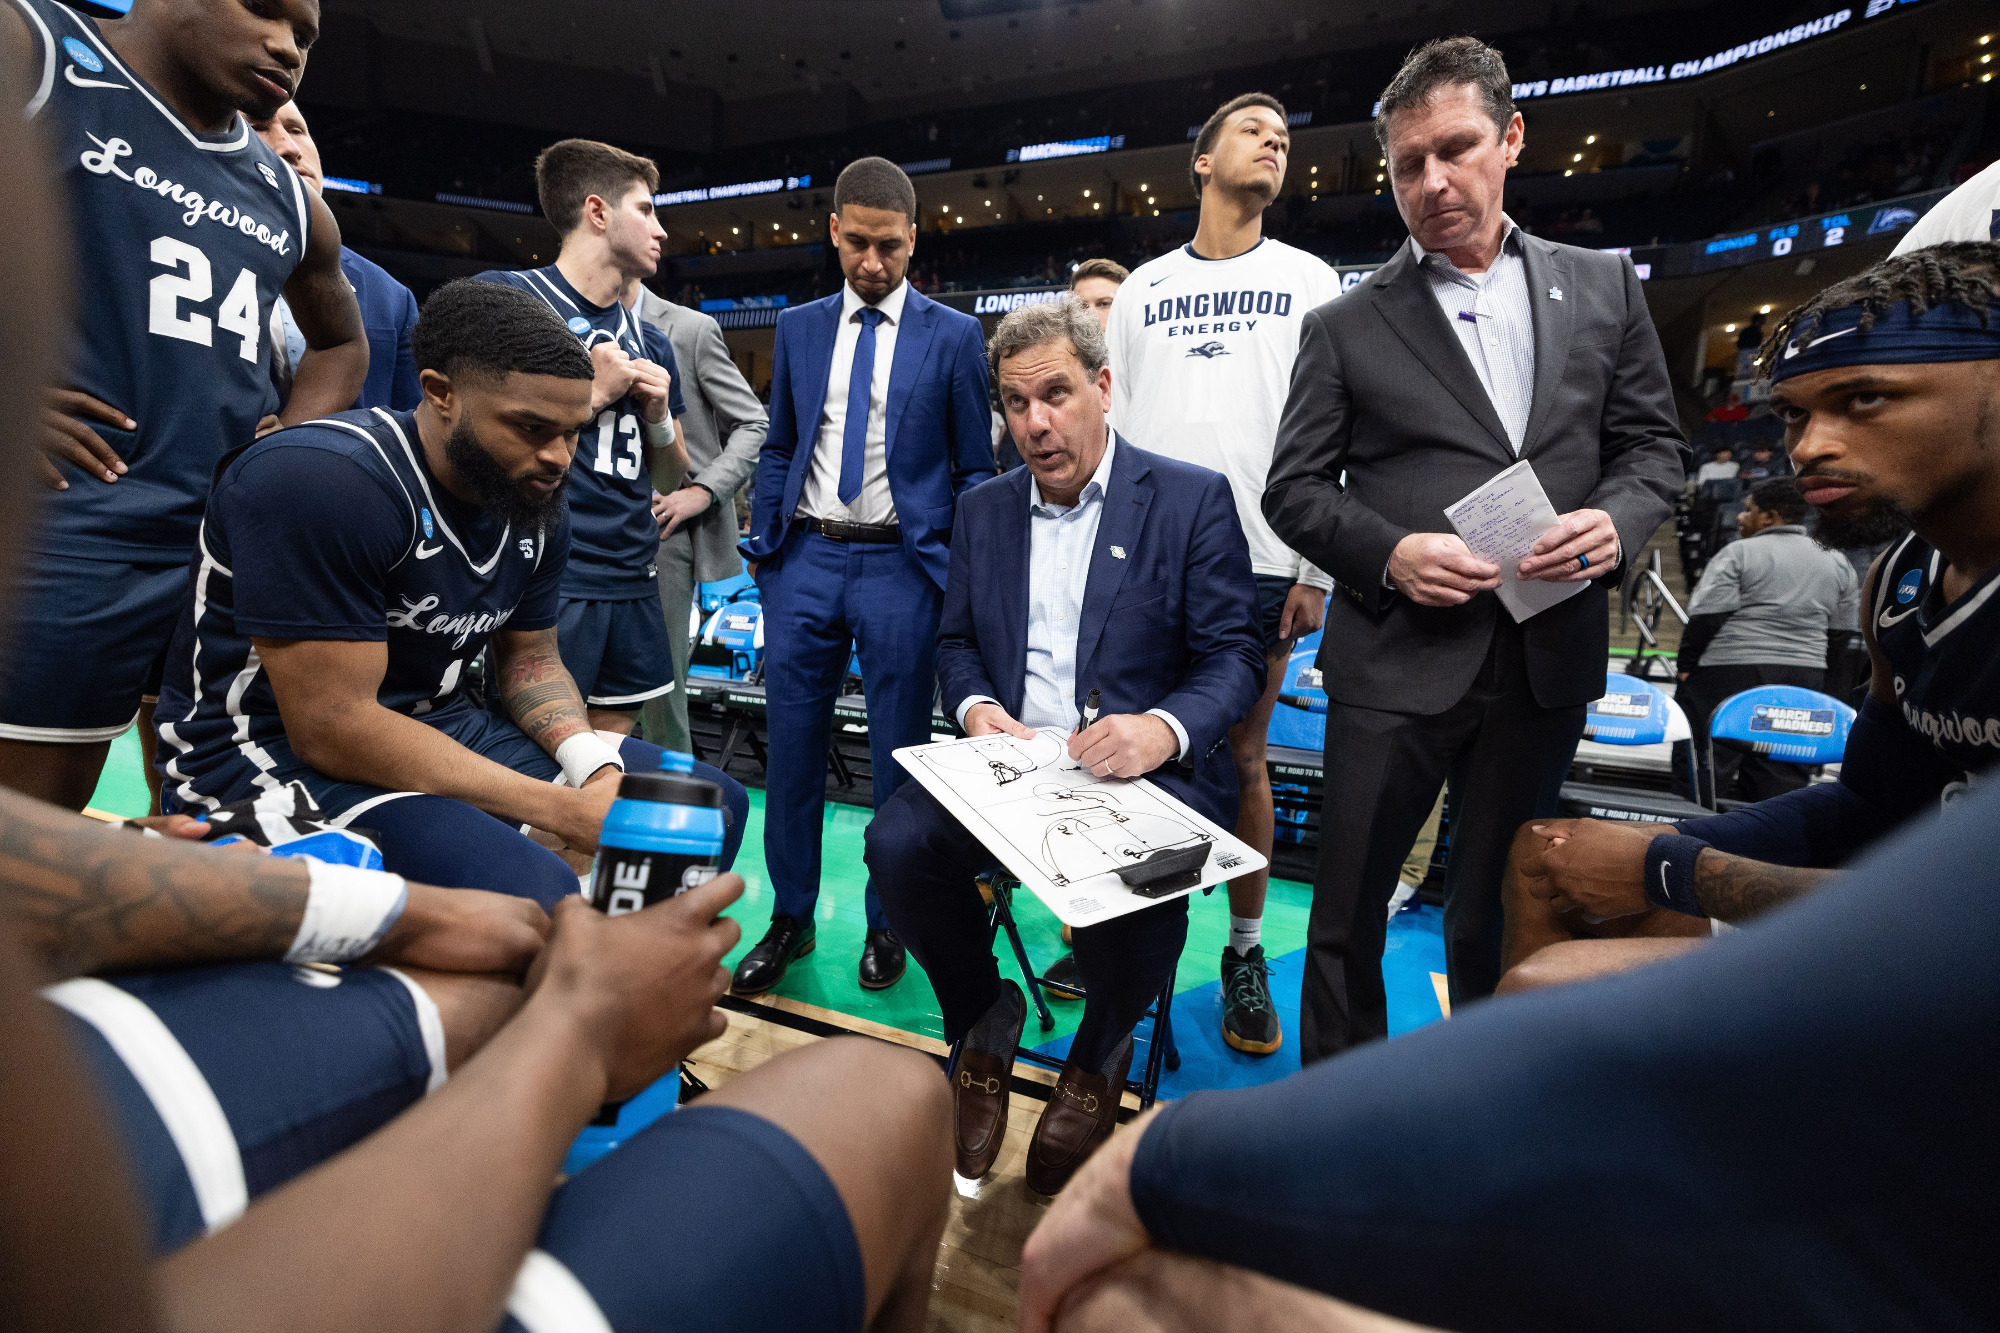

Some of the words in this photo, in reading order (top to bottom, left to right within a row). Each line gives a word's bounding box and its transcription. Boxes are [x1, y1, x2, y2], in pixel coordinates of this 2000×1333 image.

[1512, 80, 1548, 100] EN'S
[1549, 65, 1665, 95] BASKETBALL
[1669, 9, 1853, 78] CHAMPIONSHIP
[80, 129, 290, 256] Longwood
[654, 188, 709, 206] BASKETBALL
[709, 178, 784, 199] CHAMPIONSHIP
[1824, 227, 1845, 247] 2
[1772, 238, 1793, 256] 0
[149, 236, 260, 364] 24
[974, 290, 1071, 314] LONGWOO
[1144, 290, 1292, 327] LONGWOOD
[1168, 320, 1257, 337] ENERGY
[594, 410, 643, 480] 13
[1599, 693, 1632, 705] ARCH
[1597, 702, 1650, 716] MADNESS
[1767, 708, 1812, 721] MARCH
[1772, 718, 1833, 733] MADNESS
[1287, 767, 1304, 775] ROAD
[1590, 807, 1607, 816] THE
[1606, 809, 1629, 820] ROAD
[1629, 812, 1640, 821] TO
